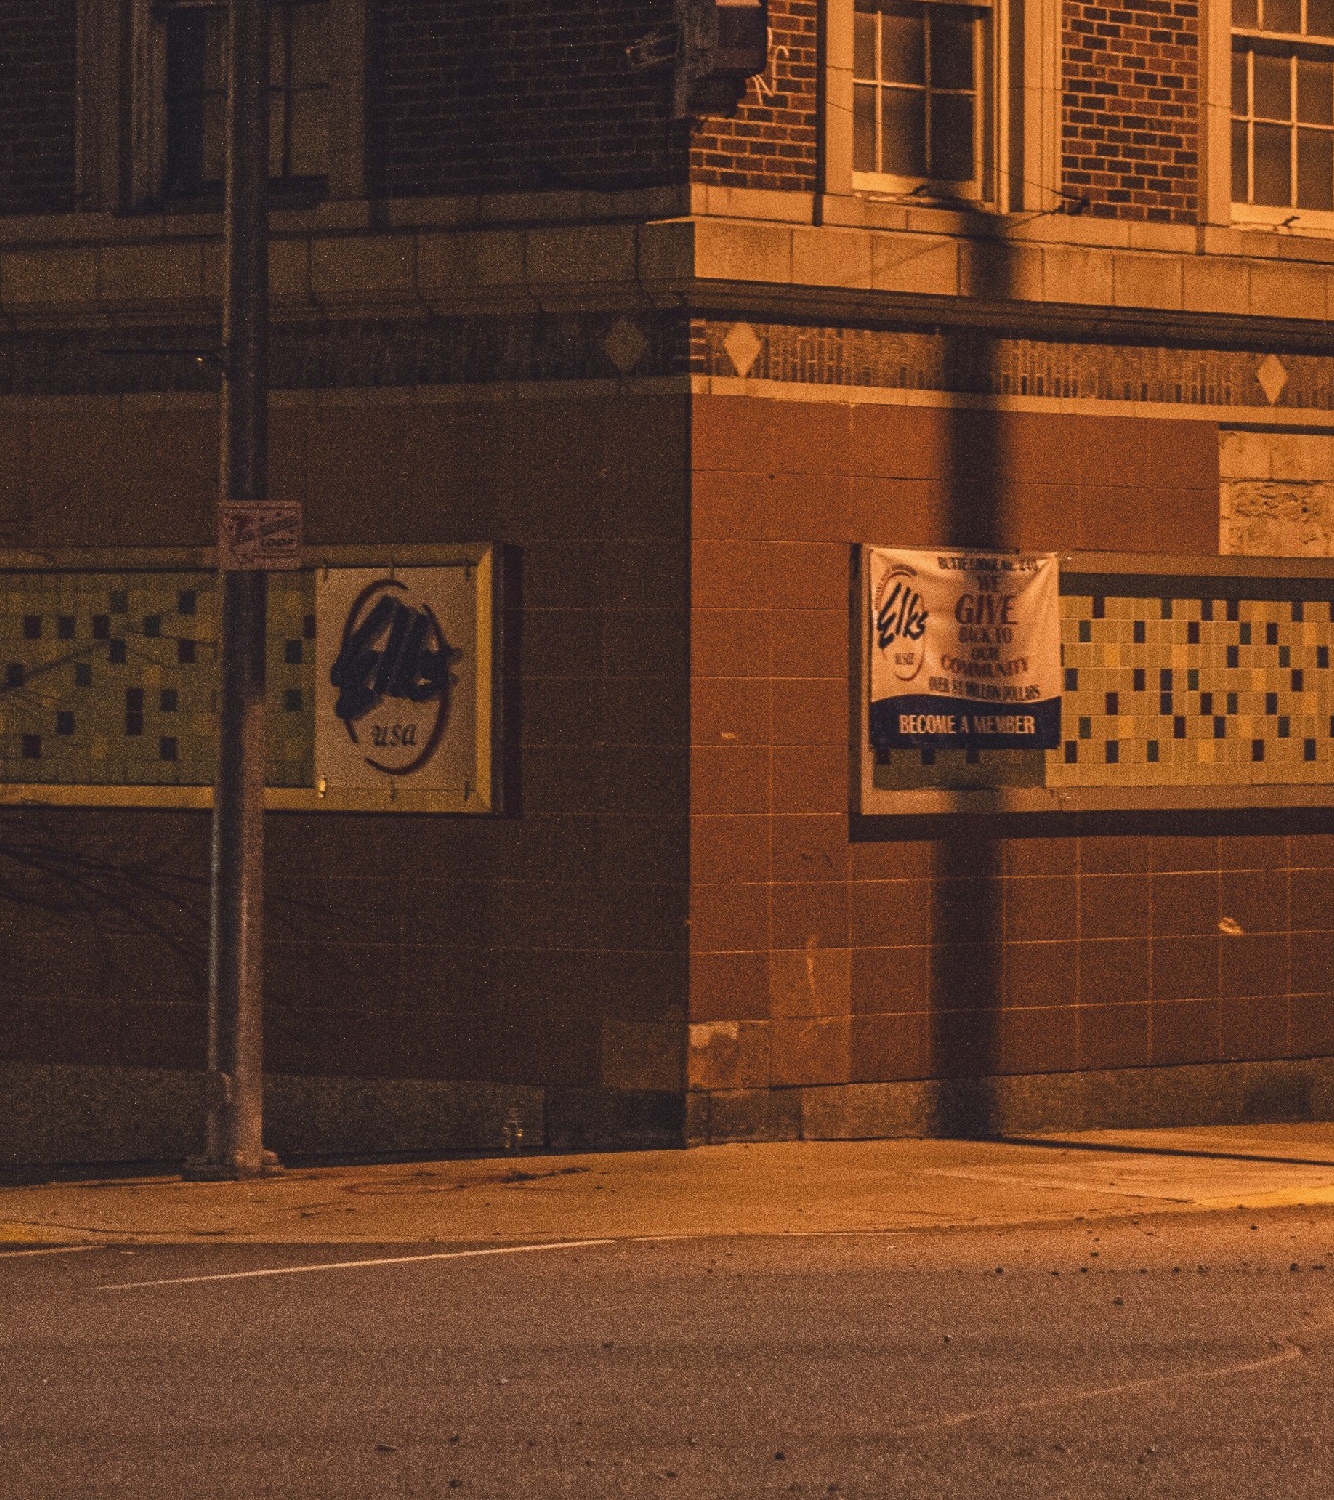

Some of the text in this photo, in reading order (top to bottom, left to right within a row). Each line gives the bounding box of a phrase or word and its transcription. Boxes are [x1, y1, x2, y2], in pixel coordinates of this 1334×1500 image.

[877, 583, 928, 648] Elks
[955, 593, 1018, 625] GIVE
[993, 626, 1013, 644] TO
[941, 654, 1028, 678] COMMUNITY
[899, 714, 1036, 734] BECOME A MEMBER
